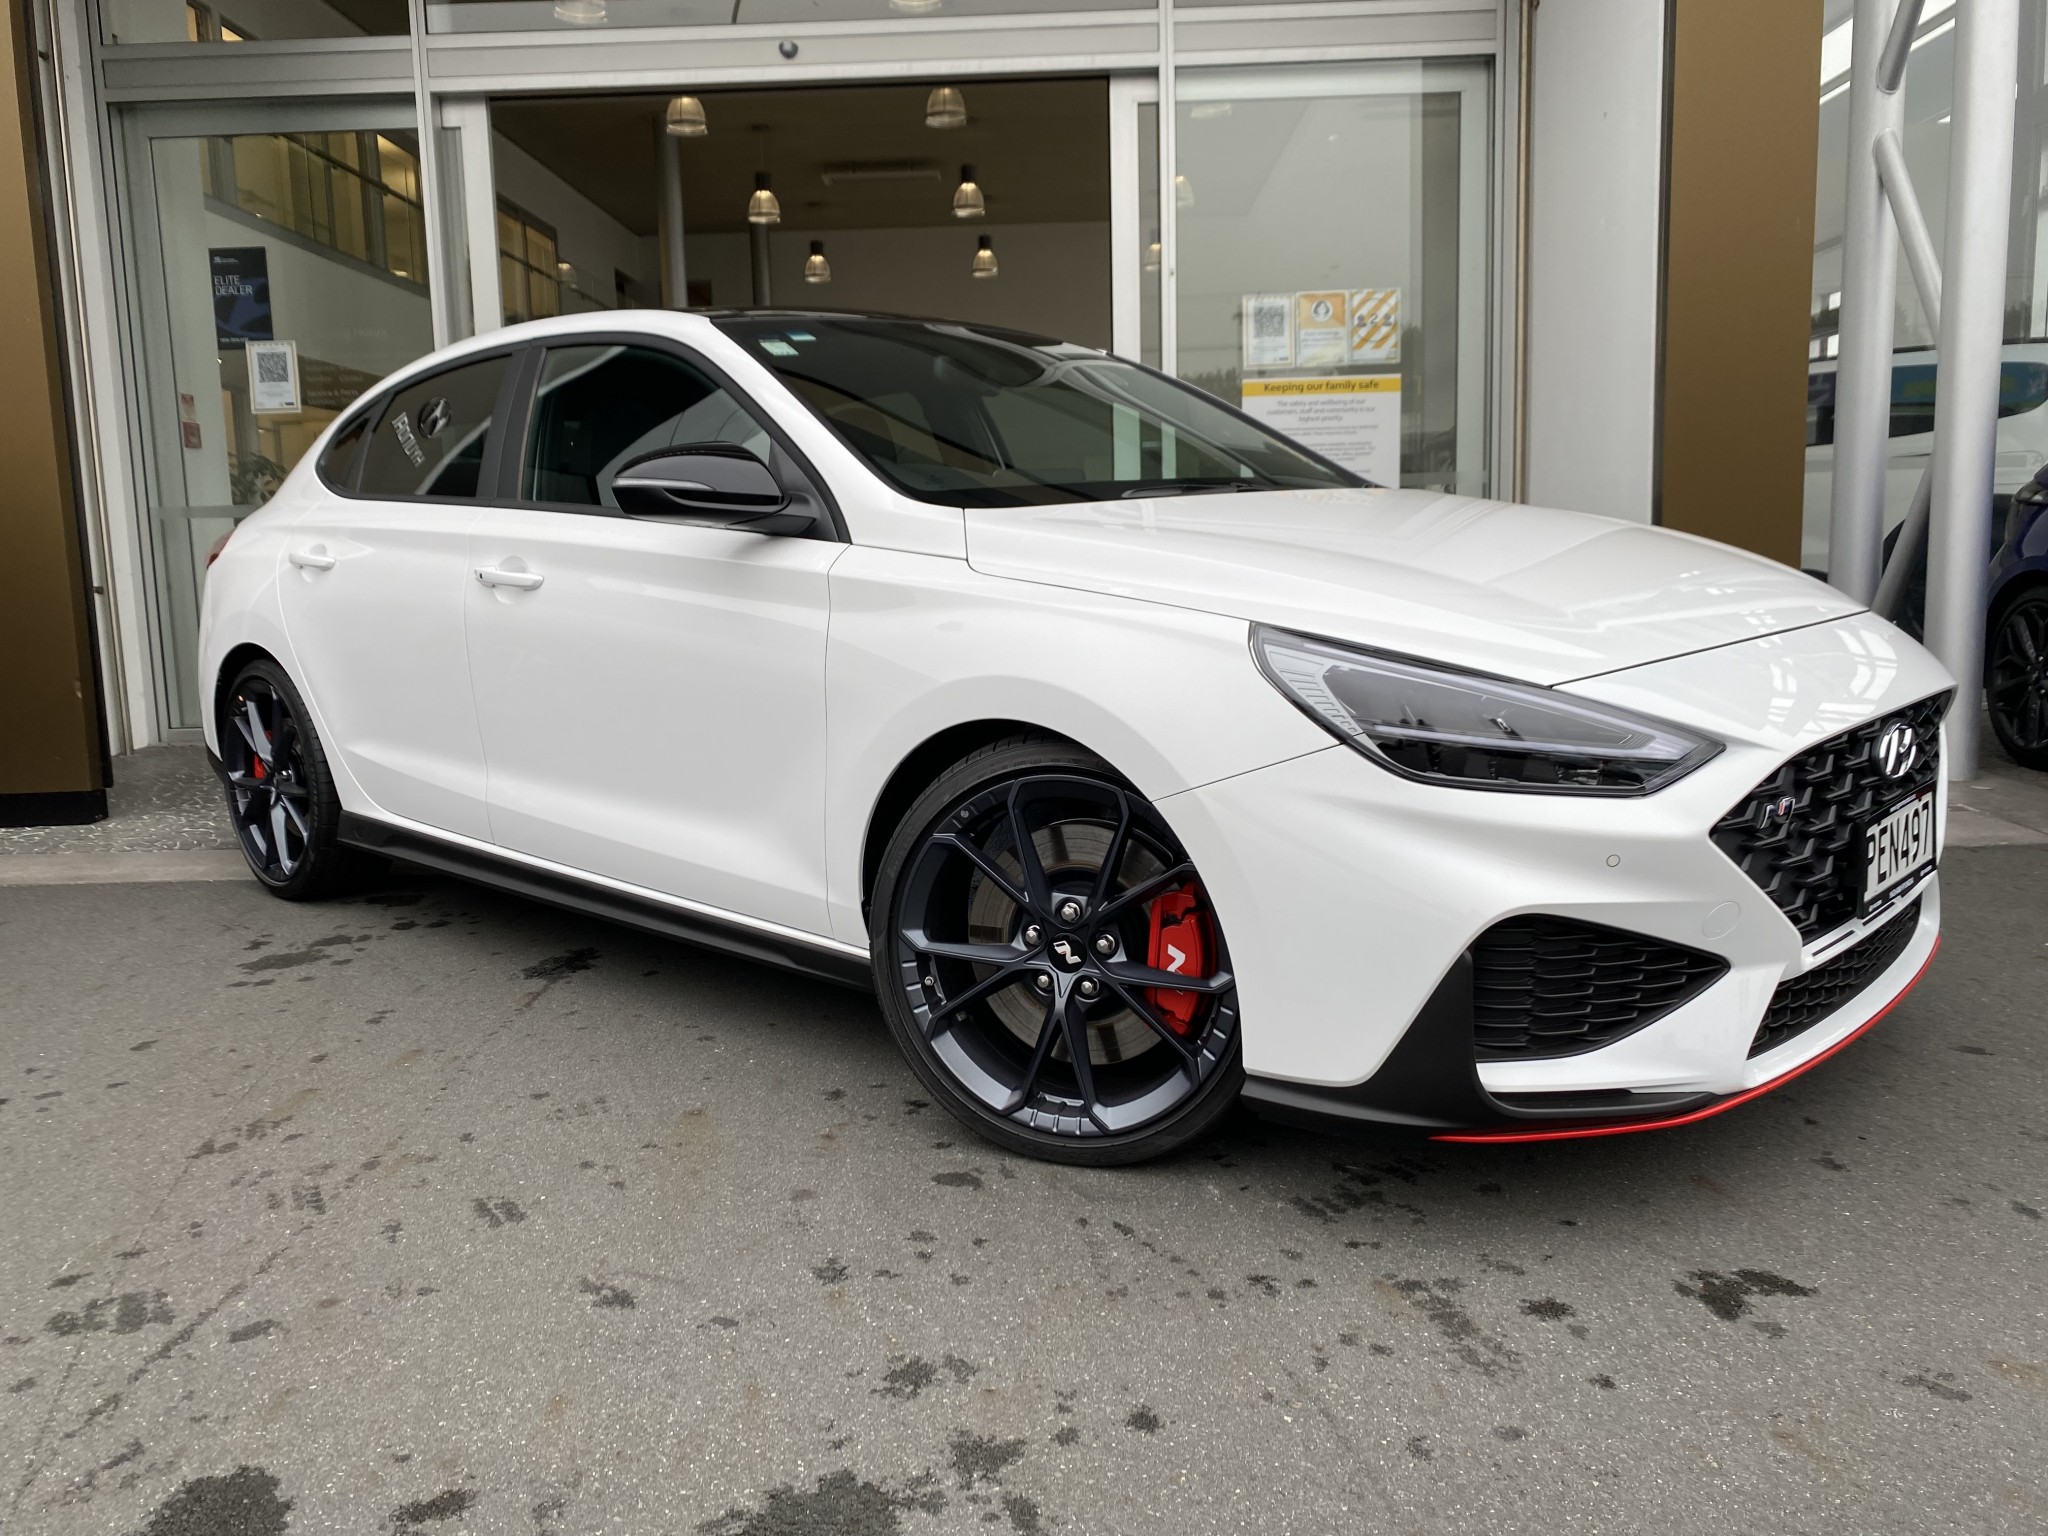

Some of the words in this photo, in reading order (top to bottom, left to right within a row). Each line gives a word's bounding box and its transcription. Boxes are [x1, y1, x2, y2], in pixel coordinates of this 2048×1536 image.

[214, 275, 240, 286] ELITE
[215, 284, 253, 296] DEALER
[1264, 383, 1304, 394] Keeping
[1306, 383, 1323, 391] our
[1325, 381, 1357, 392] family
[1358, 380, 1380, 390] safe
[1864, 799, 1930, 886] PEN497
